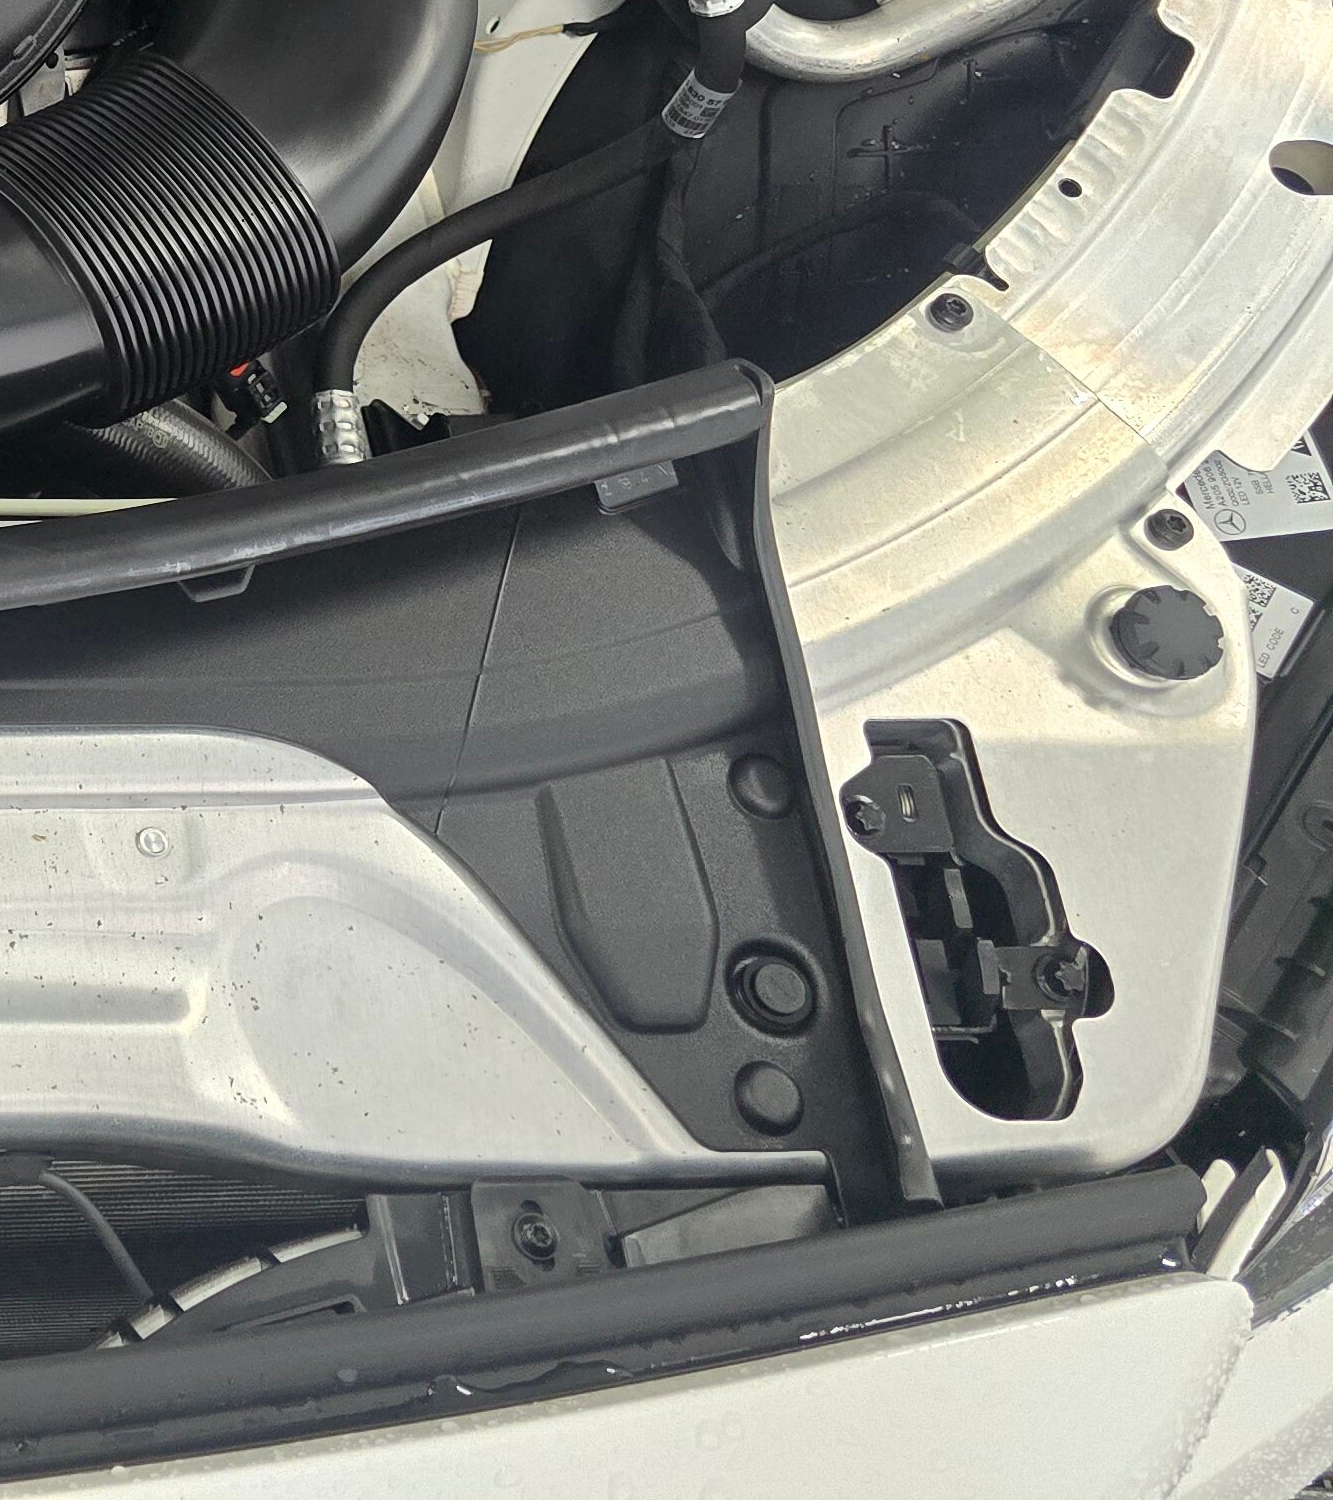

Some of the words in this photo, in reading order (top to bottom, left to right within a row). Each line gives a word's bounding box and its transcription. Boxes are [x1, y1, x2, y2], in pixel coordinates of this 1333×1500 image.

[1211, 484, 1228, 507] A205
[1238, 491, 1251, 506] LED
[1257, 652, 1271, 668] LED
[1266, 628, 1284, 650] CODE
[1289, 606, 1300, 615] C
